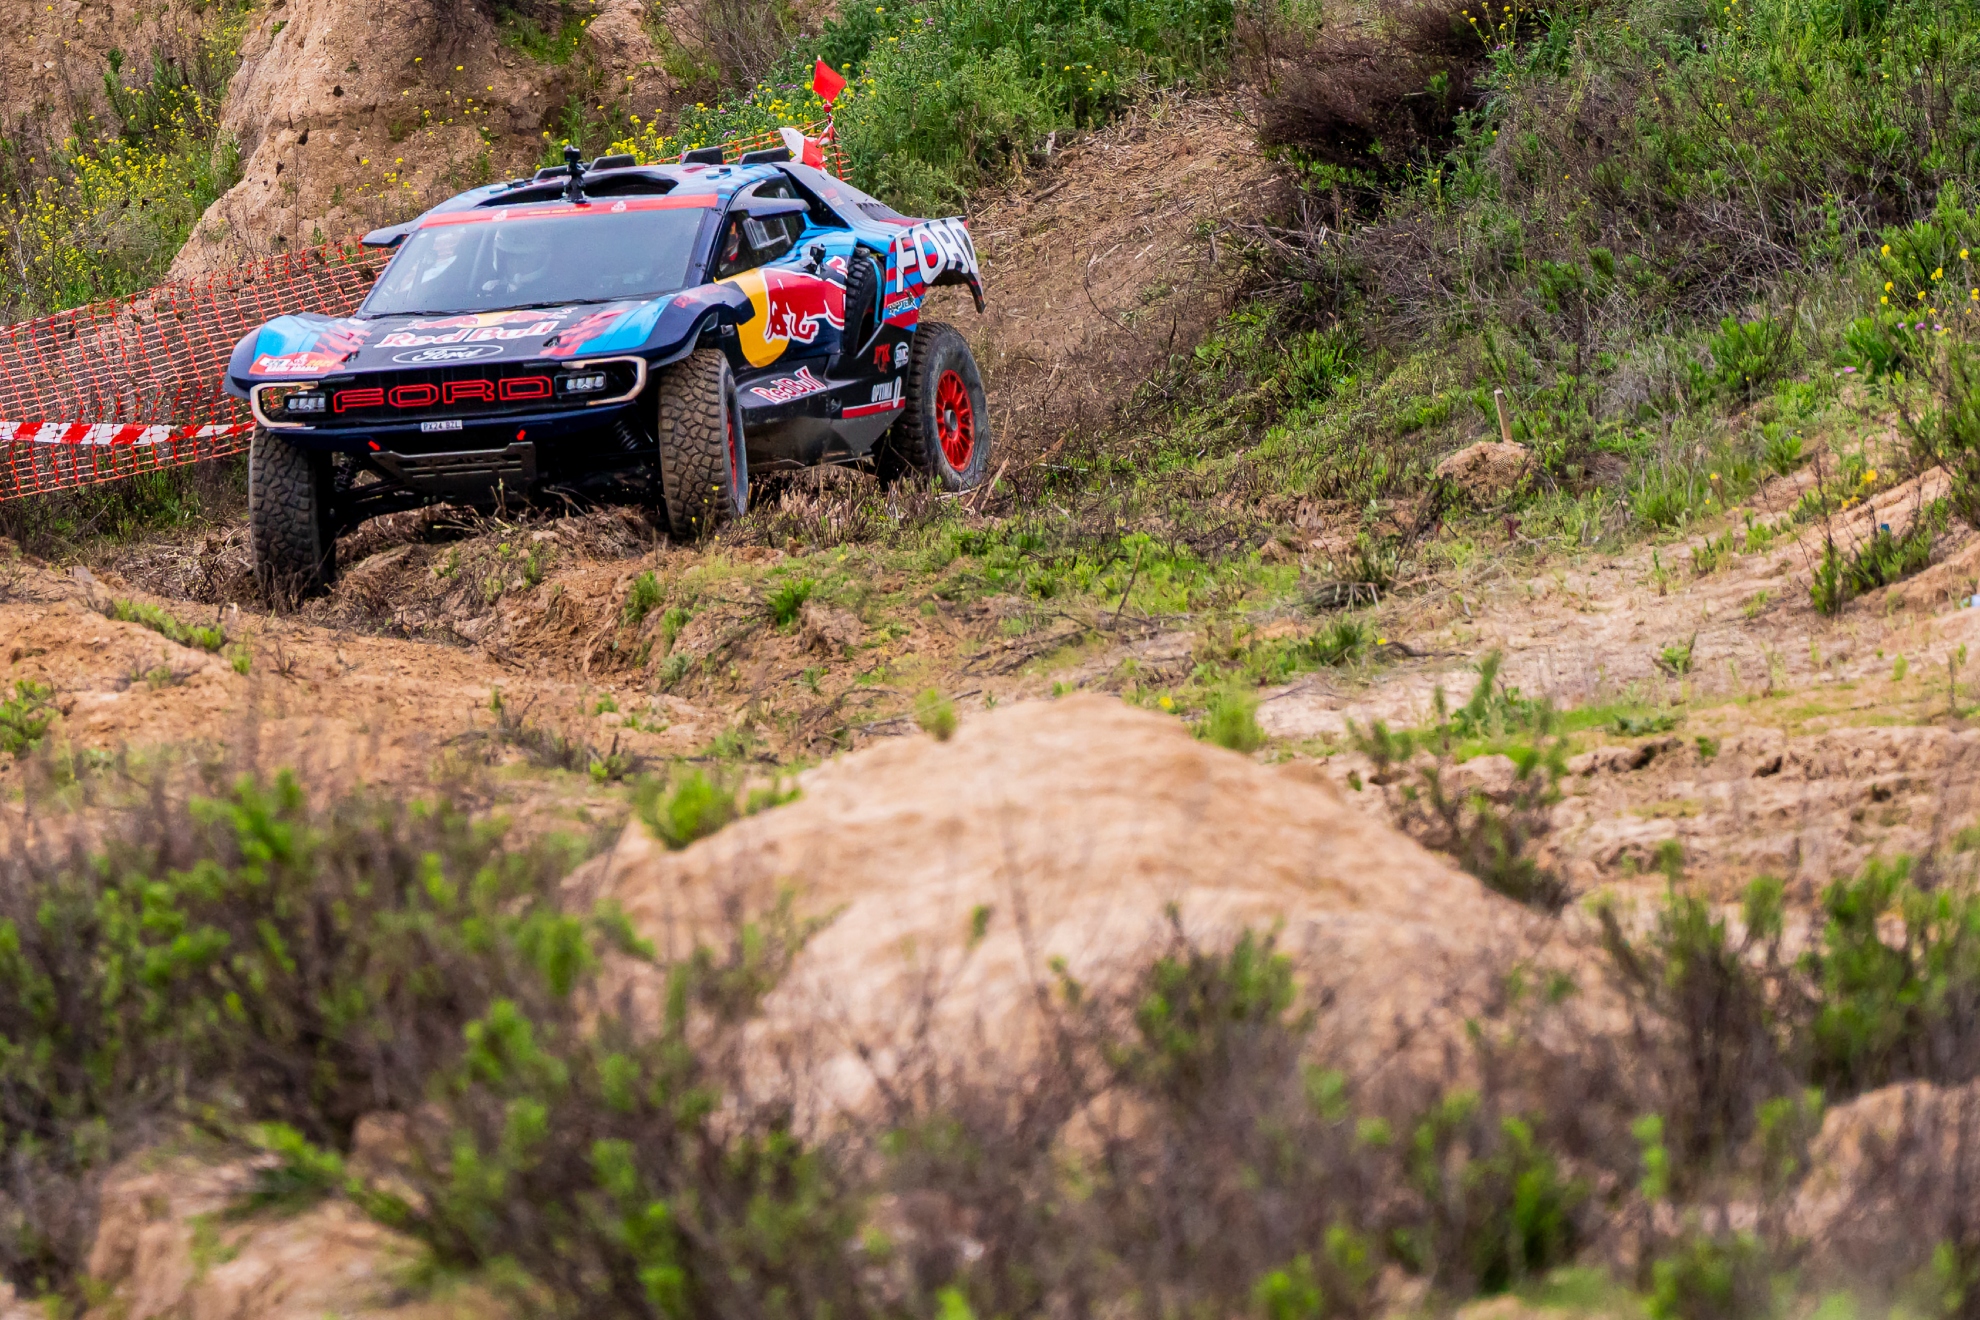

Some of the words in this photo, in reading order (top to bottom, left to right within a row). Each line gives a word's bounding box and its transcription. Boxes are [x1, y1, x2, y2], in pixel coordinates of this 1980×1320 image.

[895, 216, 979, 294] FORD
[373, 328, 471, 348] Red
[464, 321, 560, 343] Bull
[412, 346, 484, 362] Ford
[333, 376, 552, 413] FORD
[750, 380, 801, 404] Red
[777, 365, 828, 397] Bull
[871, 381, 893, 402] OPTIMA
[423, 422, 443, 431] PX24
